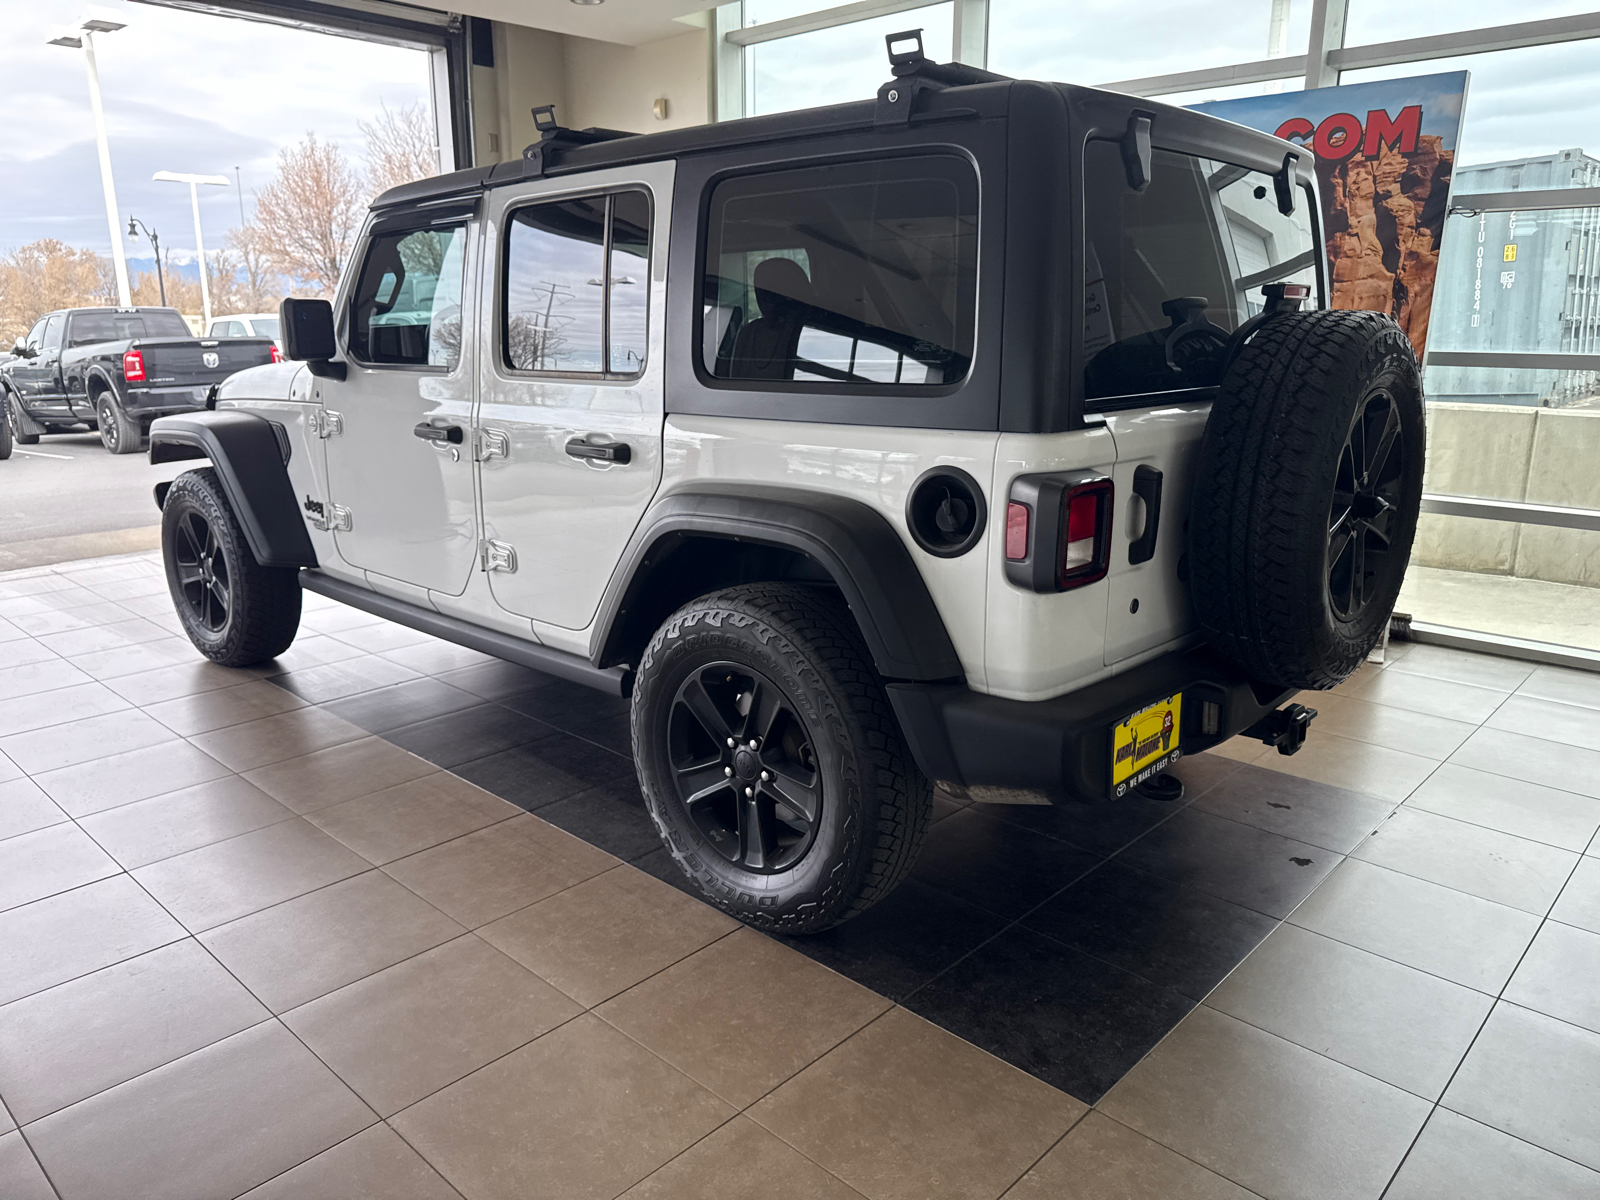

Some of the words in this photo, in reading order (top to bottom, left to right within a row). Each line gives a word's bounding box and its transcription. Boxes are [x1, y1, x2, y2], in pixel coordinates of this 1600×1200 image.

[670, 630, 824, 729] BRIDGESTONE
[1164, 715, 1171, 727] 32
[1130, 777, 1137, 788] WE
[1138, 768, 1150, 783] MAKE
[1152, 765, 1156, 775] IT
[1157, 757, 1168, 771] EASY
[669, 829, 780, 909] DUELER
